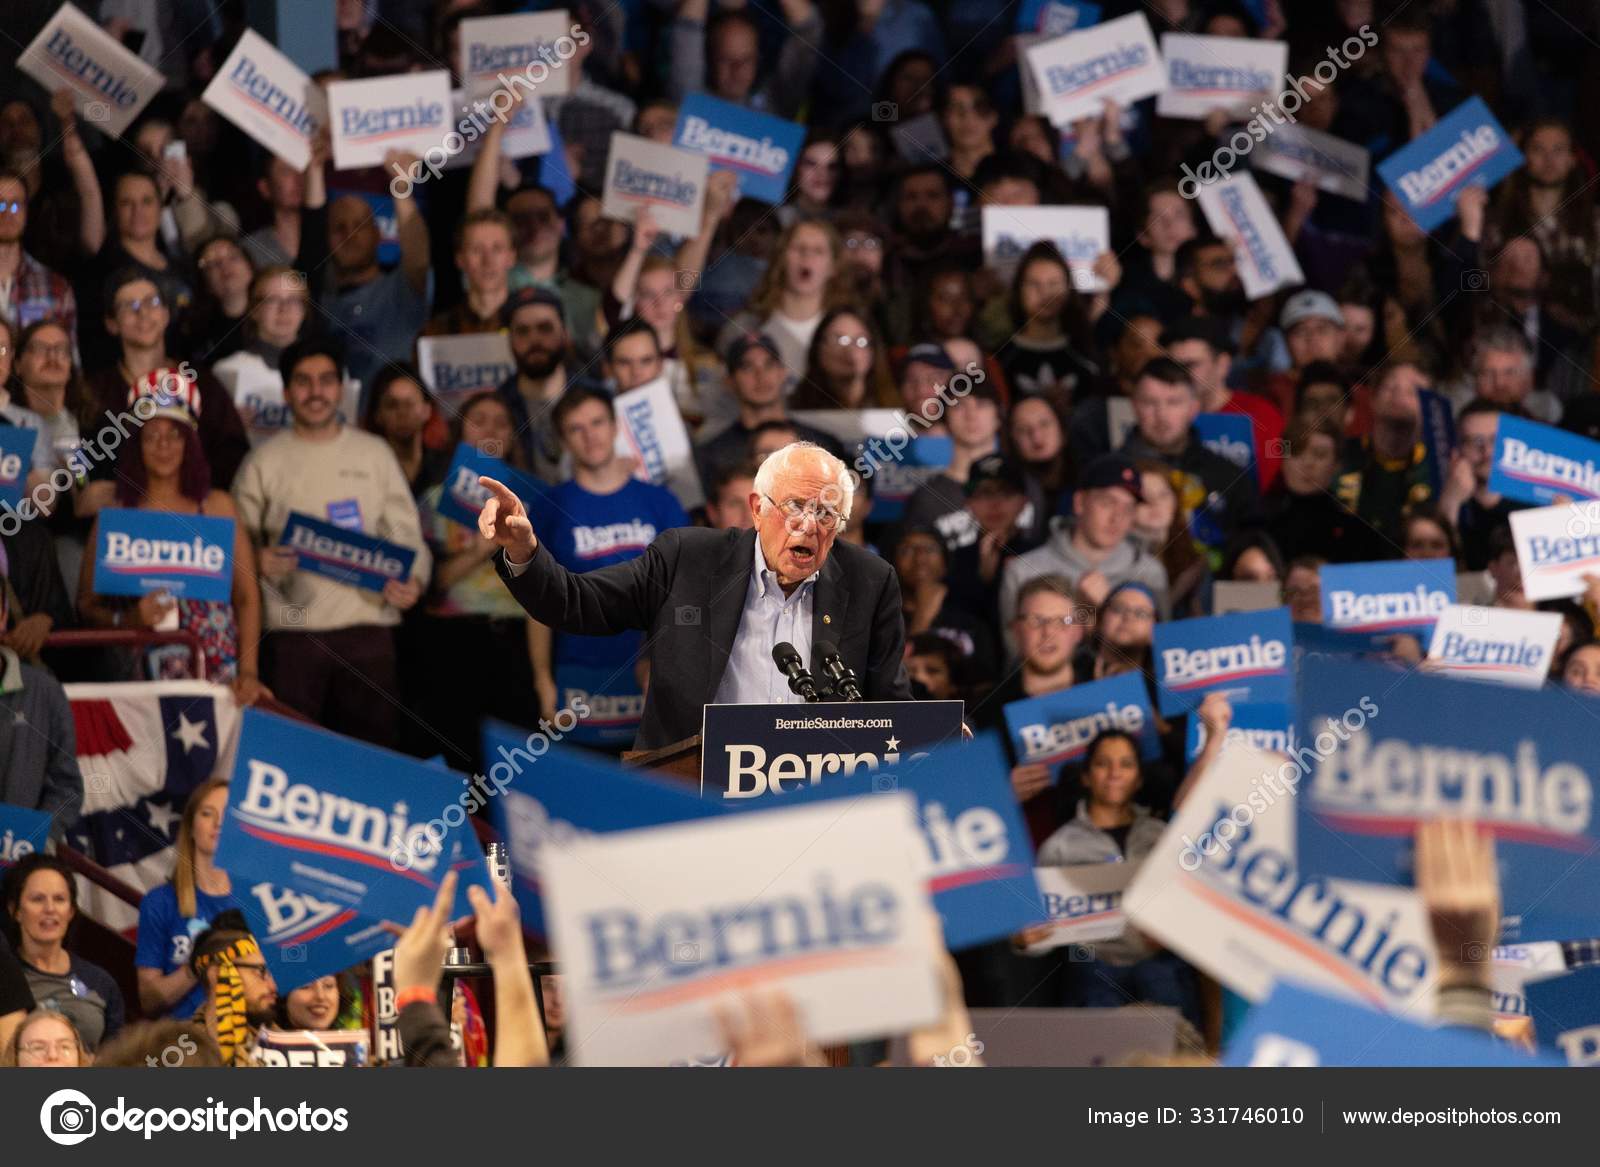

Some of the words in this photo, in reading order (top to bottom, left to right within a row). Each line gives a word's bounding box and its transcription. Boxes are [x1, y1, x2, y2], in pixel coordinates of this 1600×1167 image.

[47, 28, 138, 110] Bernie
[1046, 42, 1149, 93] Bernie
[1170, 58, 1275, 91] Bernie
[230, 56, 319, 136] Bernie
[340, 97, 444, 136] Bernie
[680, 114, 789, 176] Bernie
[1399, 124, 1499, 207] Bernie
[614, 157, 697, 206] Bernie
[104, 531, 225, 573] Bernie
[290, 523, 404, 576] Bernie
[573, 519, 656, 553] Bernie
[1329, 584, 1449, 622] Bernie
[1162, 635, 1286, 681] Bernie
[1442, 631, 1545, 668] Bernie
[776, 717, 892, 729] BernieSanders.com
[1020, 702, 1144, 756] Bernie
[1309, 715, 1594, 835] Bernie
[240, 759, 443, 872] Bernie
[585, 873, 899, 984] Bernie
